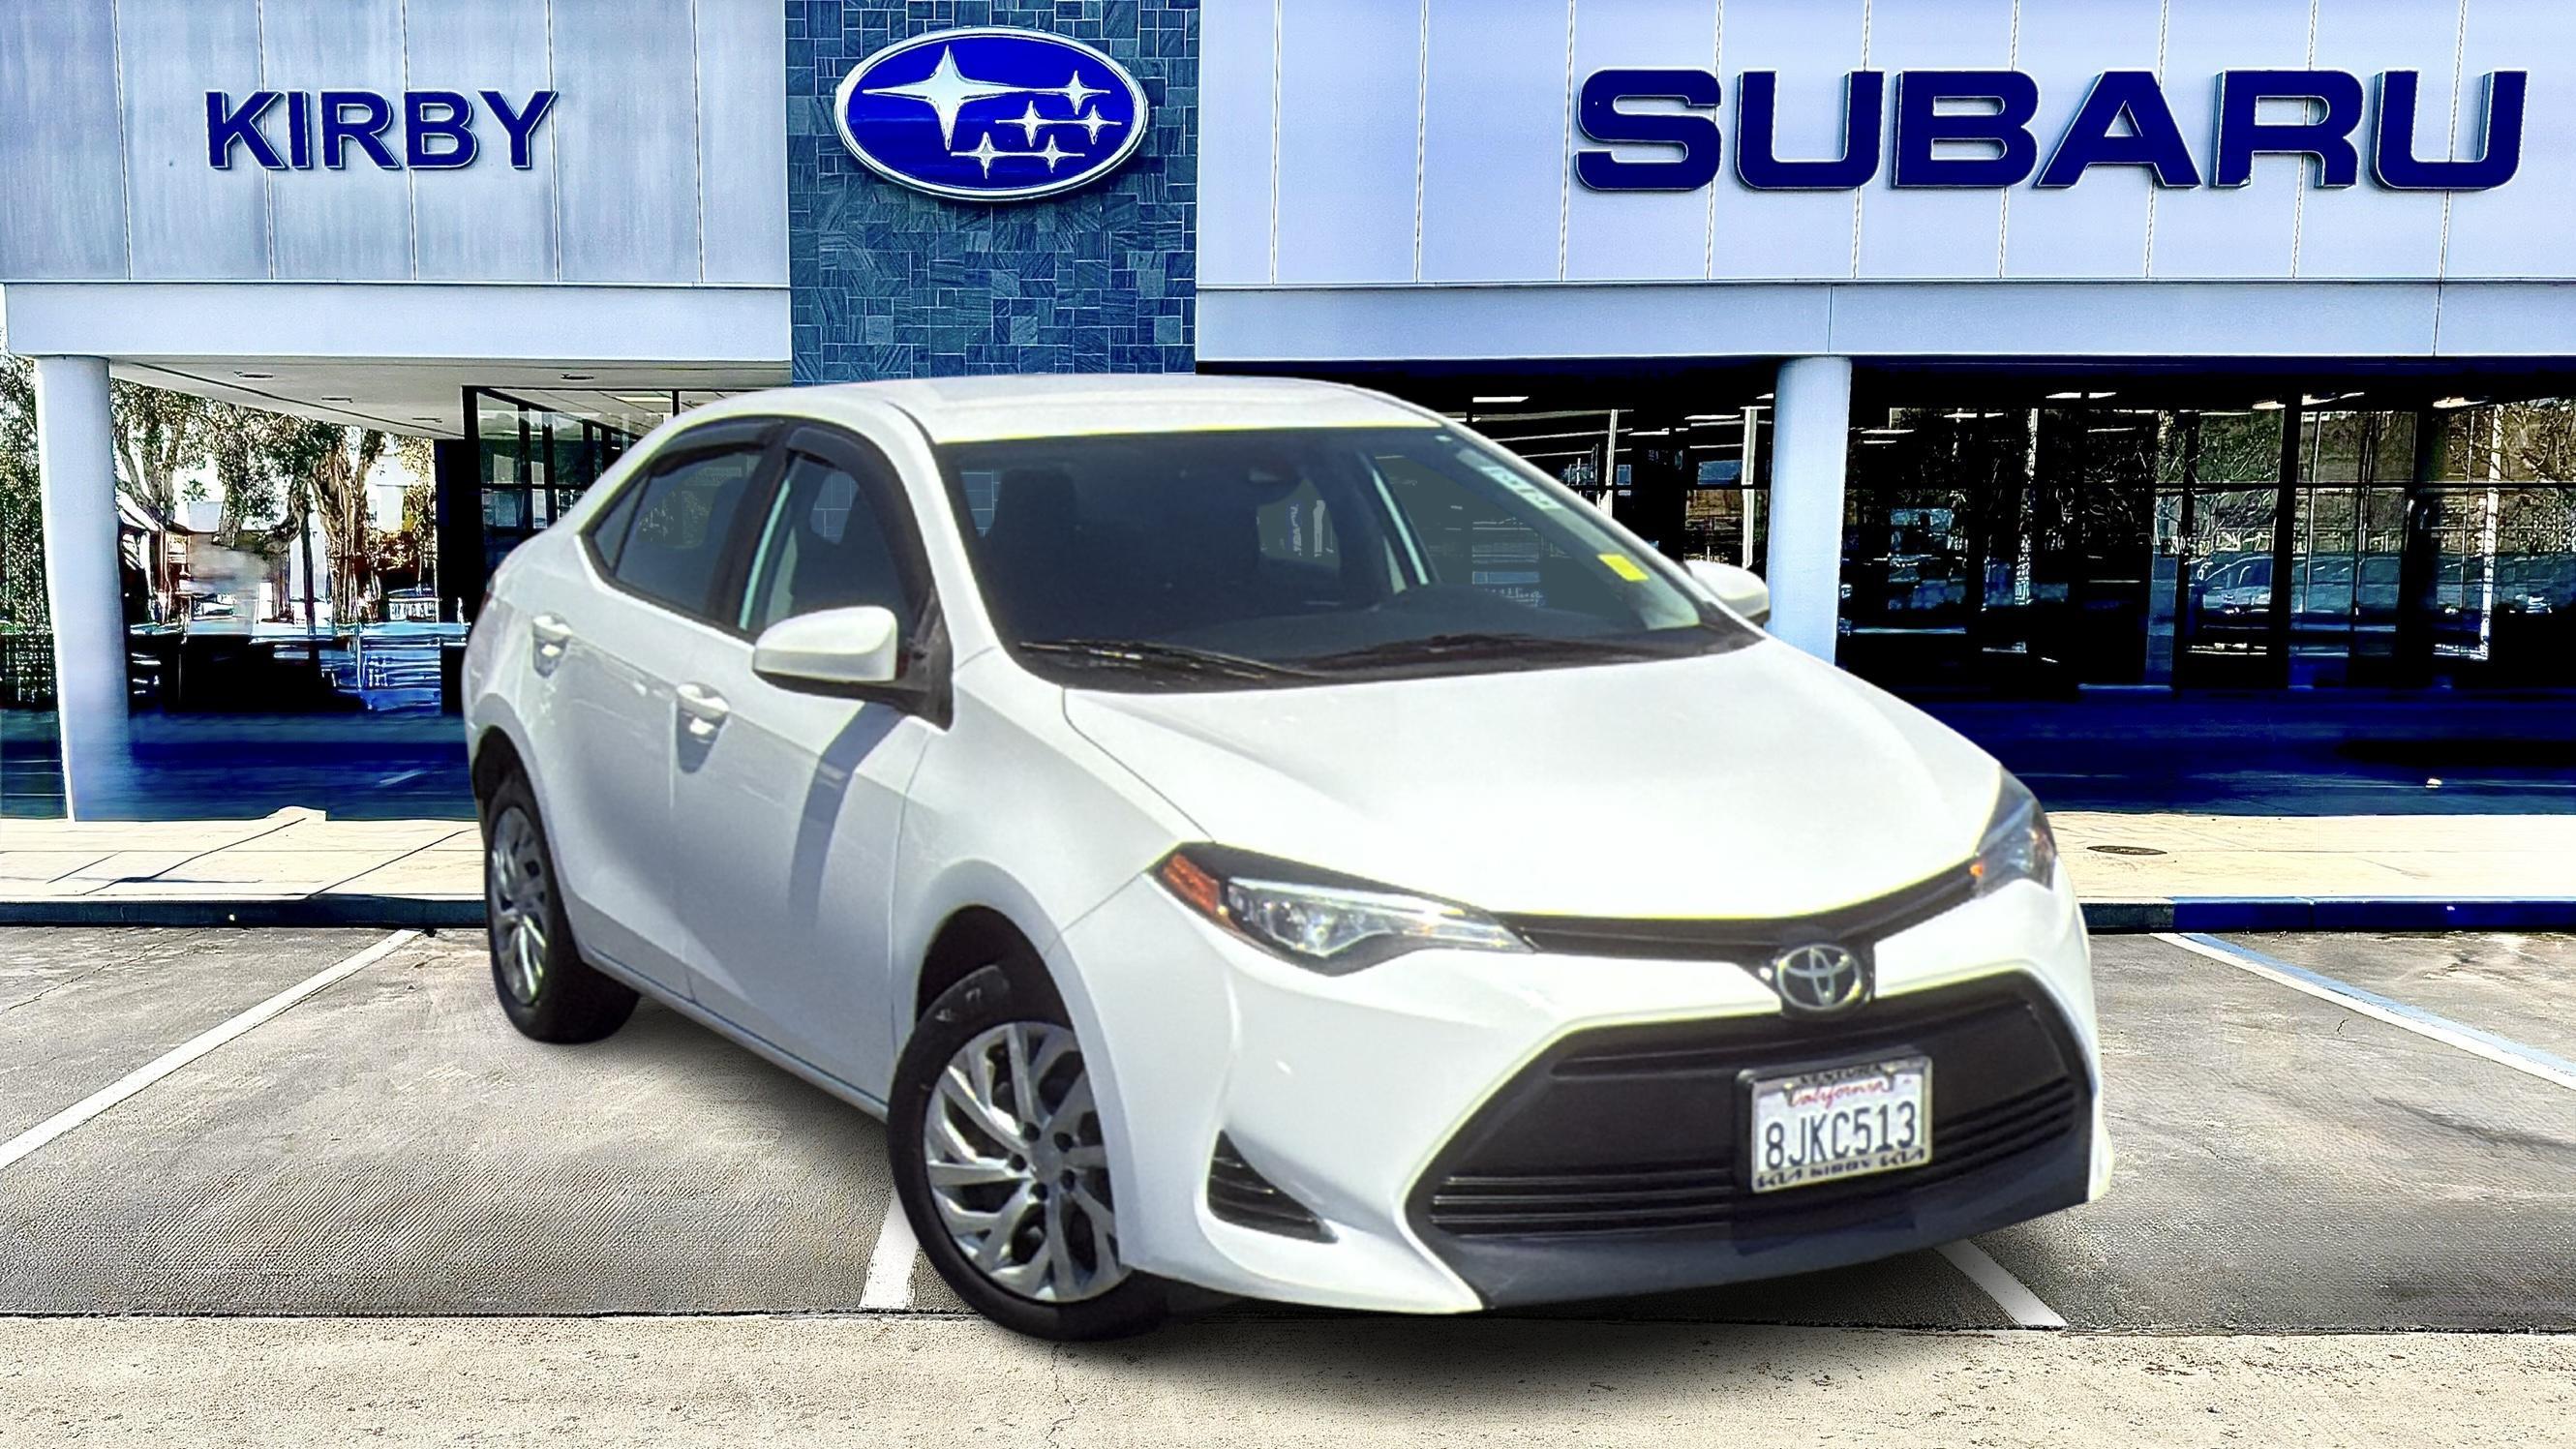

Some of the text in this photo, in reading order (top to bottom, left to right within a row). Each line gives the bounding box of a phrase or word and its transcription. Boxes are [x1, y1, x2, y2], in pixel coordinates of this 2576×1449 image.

[205, 89, 559, 170] KIRBY
[1576, 69, 2529, 192] SUBARU
[1788, 1079, 1891, 1109] California
[1765, 1100, 1917, 1170] 8JKC513
